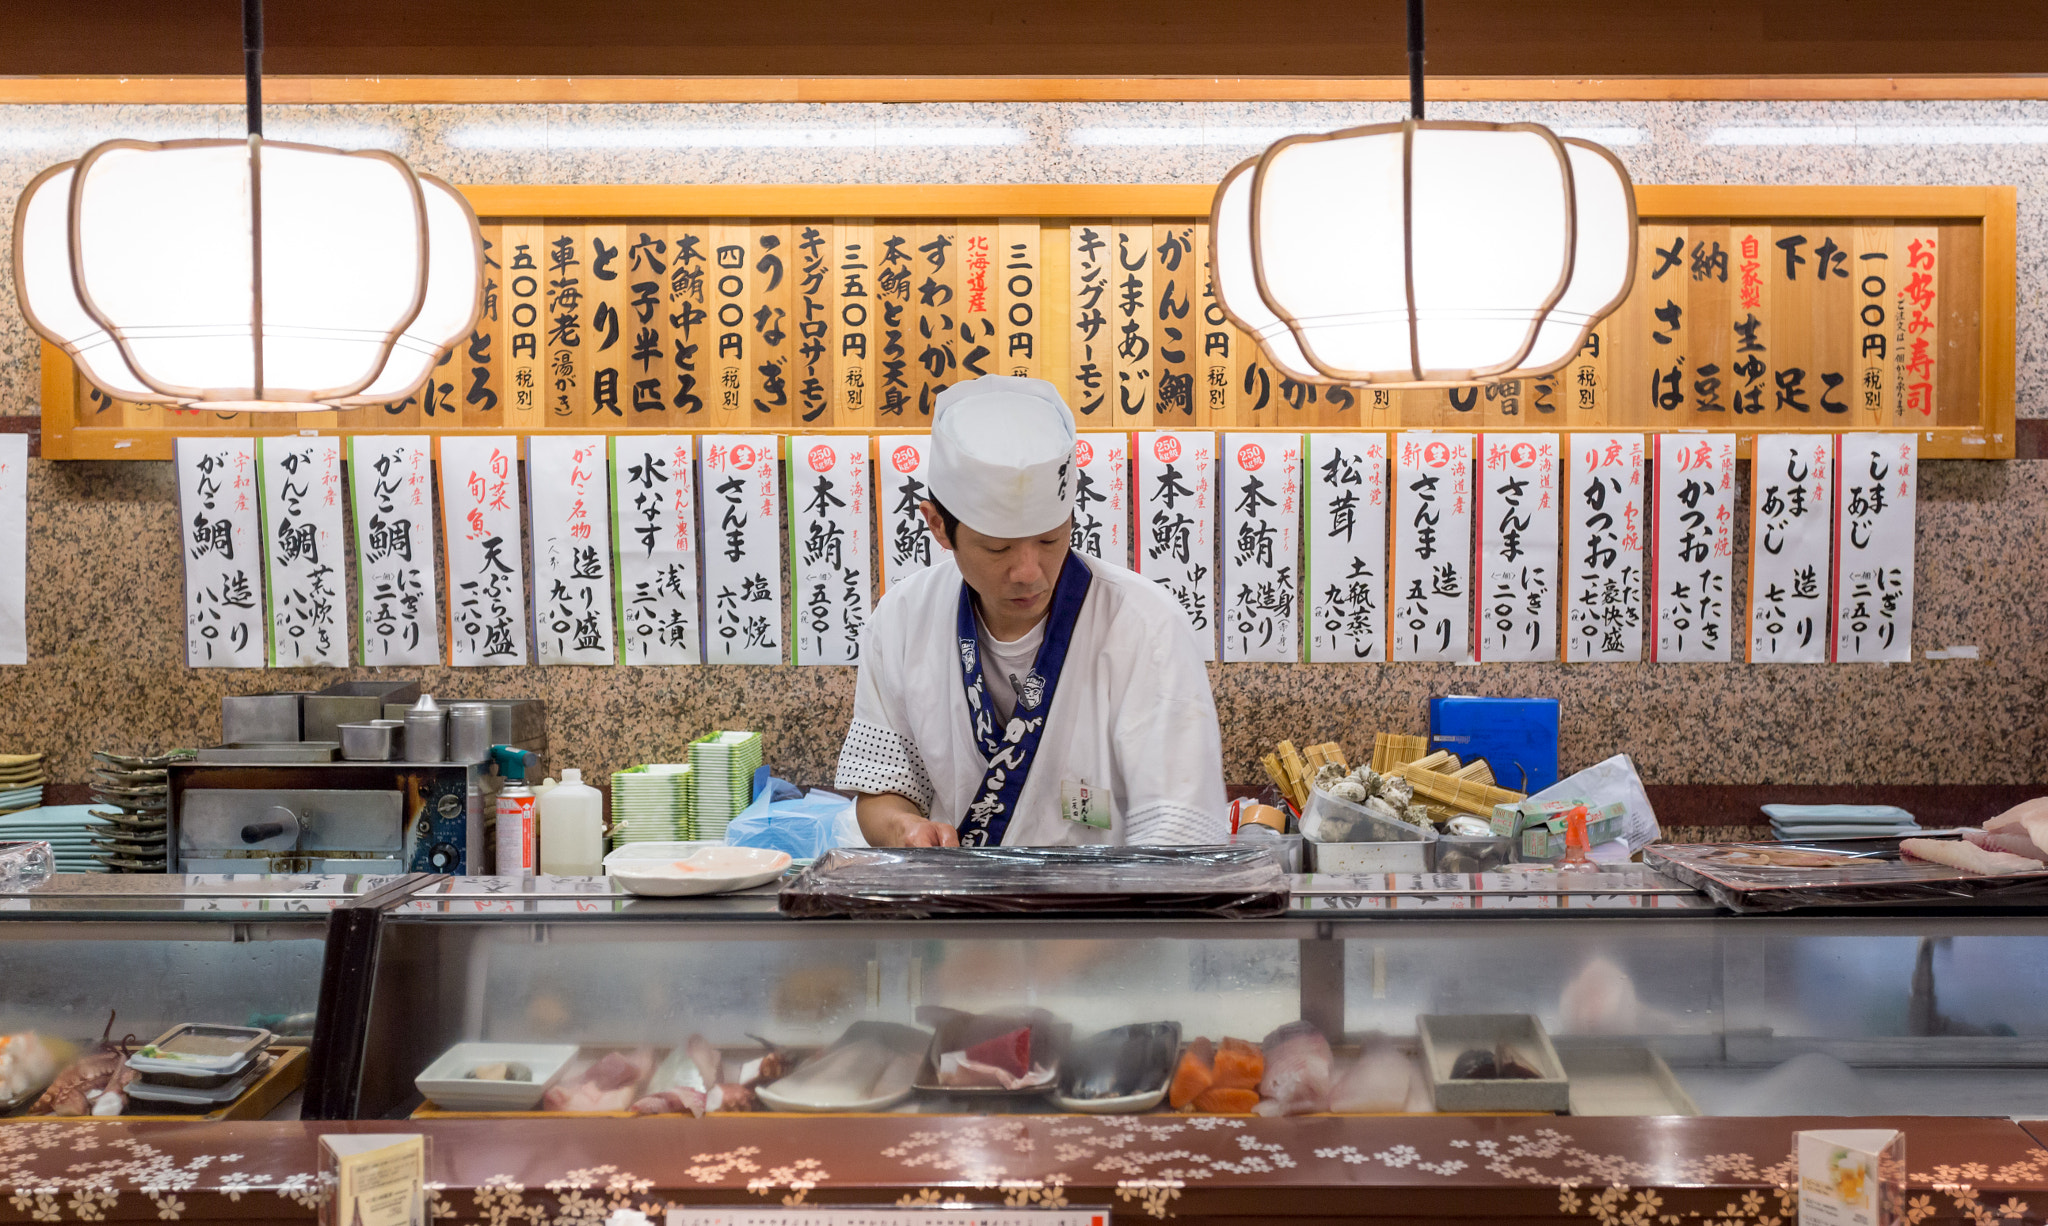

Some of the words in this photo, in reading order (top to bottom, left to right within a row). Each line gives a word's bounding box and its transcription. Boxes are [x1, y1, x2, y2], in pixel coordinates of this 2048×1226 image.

[547, 235, 583, 347] 車海老
[965, 235, 990, 313] 北海道産
[1739, 234, 1764, 310] 自家製
[592, 236, 623, 417] とり貝
[629, 232, 667, 413] 穴子半匹
[668, 233, 707, 415] 本鮪中とろ
[753, 234, 788, 413] うなぎ
[798, 227, 828, 422] キングトロサーモン
[876, 235, 913, 416] 本鮪とろ天身
[960, 318, 995, 380] いく
[1075, 227, 1108, 416] キングサーモン
[1117, 232, 1150, 416] しまあじ
[1156, 228, 1194, 416] がんこ鯛
[1690, 240, 1729, 413] 納豆
[1733, 313, 1767, 415] 生ゆば
[1775, 234, 1810, 414] 下足
[1814, 236, 1850, 414] たこ
[1904, 238, 1936, 417] お好み寿司
[757, 446, 776, 518] 北海道産
[809, 447, 831, 462] 250
[849, 451, 865, 515] 地中海産
[893, 447, 915, 464] 250
[1108, 448, 1125, 511] 地中海産
[1156, 438, 1178, 453] 250
[1239, 446, 1260, 461] 250
[1281, 449, 1298, 515] 地中海産
[1367, 444, 1383, 506] 秋の味覚
[1450, 444, 1468, 515] 北海道産
[1537, 443, 1553, 511] 北海道産
[190, 451, 234, 560] がんこ鯛
[276, 448, 318, 566] がんこ鯛
[366, 447, 411, 564] がんこ鯛
[566, 445, 596, 542] がんこ名物
[627, 452, 670, 559] 水なす
[715, 475, 748, 563] さんま
[802, 475, 847, 571] 本鮪
[892, 475, 931, 567] 本鮪
[1149, 464, 1195, 565] 本鮪
[1234, 475, 1278, 568] 本鮪
[1320, 447, 1363, 544] 松茸
[1409, 473, 1440, 560] さんま
[1496, 476, 1531, 562] さんま
[1584, 476, 1622, 569] かつお
[1677, 479, 1715, 563] かつお
[222, 569, 256, 653] 造り
[397, 568, 424, 652] にぎり
[479, 536, 518, 658] 天ぷら盛
[570, 545, 605, 651] 造り盛
[740, 572, 777, 649] 塩焼
[1187, 562, 1207, 631] 中とろ
[1256, 581, 1278, 648] 造り
[1344, 556, 1375, 658] 土瓶蒸し
[1431, 561, 1462, 652] 造り
[1521, 566, 1548, 651] にぎり
[1621, 566, 1640, 627] たたき
[1700, 569, 1723, 650] たたき
[1791, 564, 1820, 648] 造り
[1878, 567, 1904, 650] にぎり
